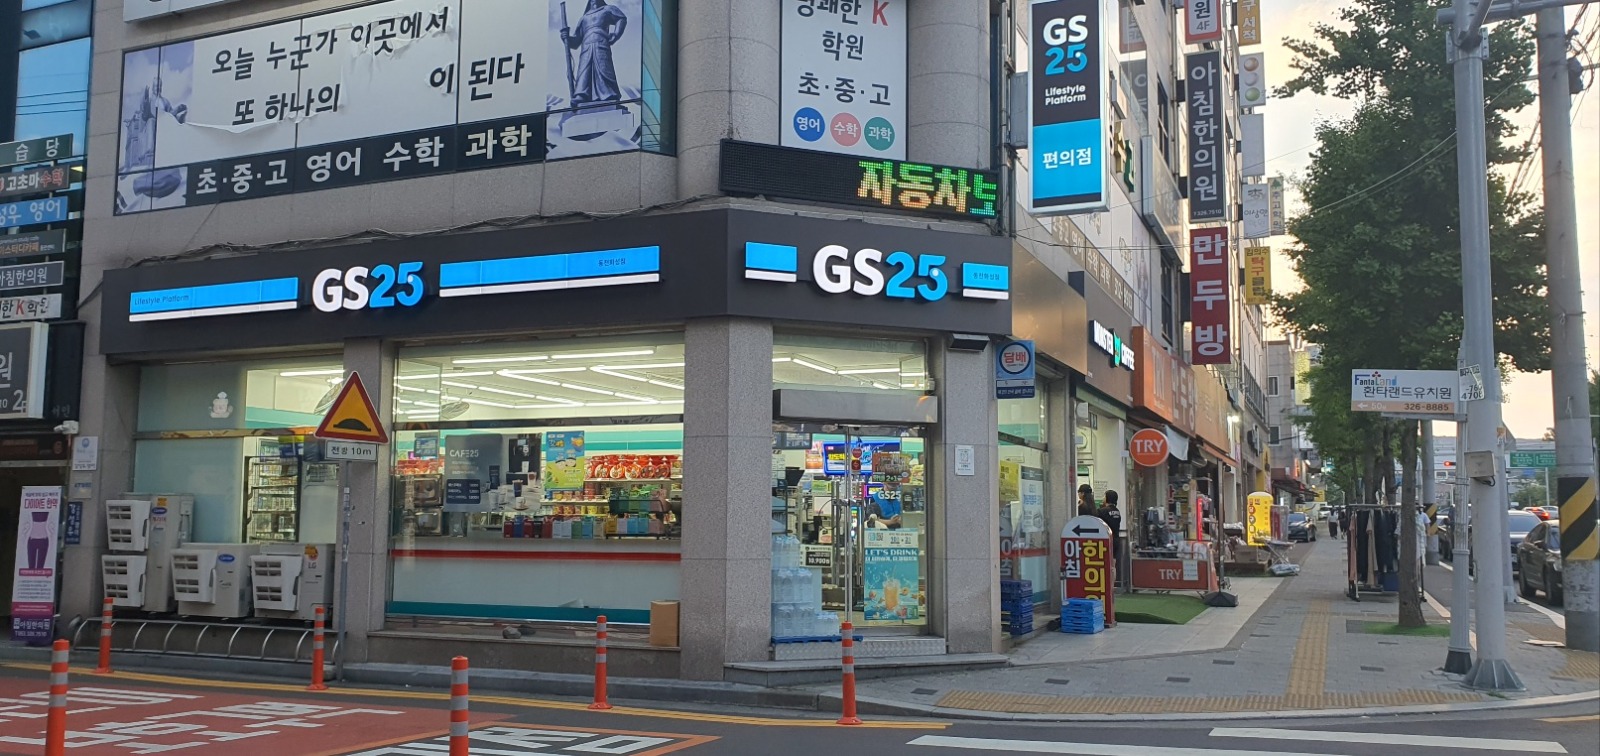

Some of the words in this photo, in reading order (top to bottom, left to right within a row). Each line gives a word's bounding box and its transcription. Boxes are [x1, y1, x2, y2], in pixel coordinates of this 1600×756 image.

[872, 0, 889, 26] K
[1043, 15, 1089, 46] GS
[1196, 20, 1211, 31] 4F
[211, 47, 255, 81] 오늘
[266, 28, 338, 71] 누군가
[350, 6, 449, 56] 이곳에서
[822, 30, 864, 61] 학원
[1044, 43, 1089, 76] 25
[429, 63, 455, 94] 이
[468, 52, 525, 101] 된다
[1045, 84, 1086, 97] Lifestyle
[1045, 93, 1086, 106] Platform
[231, 98, 255, 126] 또
[264, 83, 341, 121] 하나의
[796, 116, 821, 132] 영어
[833, 121, 859, 138] 수학
[868, 125, 892, 142] 과학
[1191, 61, 1218, 201] 아침한의원
[306, 147, 362, 183] 영어
[382, 136, 445, 172] 수학
[465, 124, 533, 160] 과학
[1042, 147, 1092, 169] 편의점
[29, 199, 60, 221] 영어
[812, 244, 948, 301] GS25
[312, 261, 424, 313] GS25
[1193, 233, 1228, 356] 만두방
[134, 297, 160, 306] Lifestyle
[162, 294, 190, 303] Platform
[1004, 351, 1027, 364] 담배
[1363, 385, 1452, 400] 환타랜드유치원
[1404, 402, 1449, 412] 326-8885
[331, 446, 348, 455] 전방
[351, 447, 372, 455] 10m
[449, 449, 479, 458] CAFE25
[1134, 439, 1164, 453] TRY
[878, 490, 901, 500] GS25
[308, 561, 317, 569] LG
[1064, 540, 1082, 579] 아침
[1083, 540, 1107, 618] 한의
[1158, 568, 1182, 580] TRY
